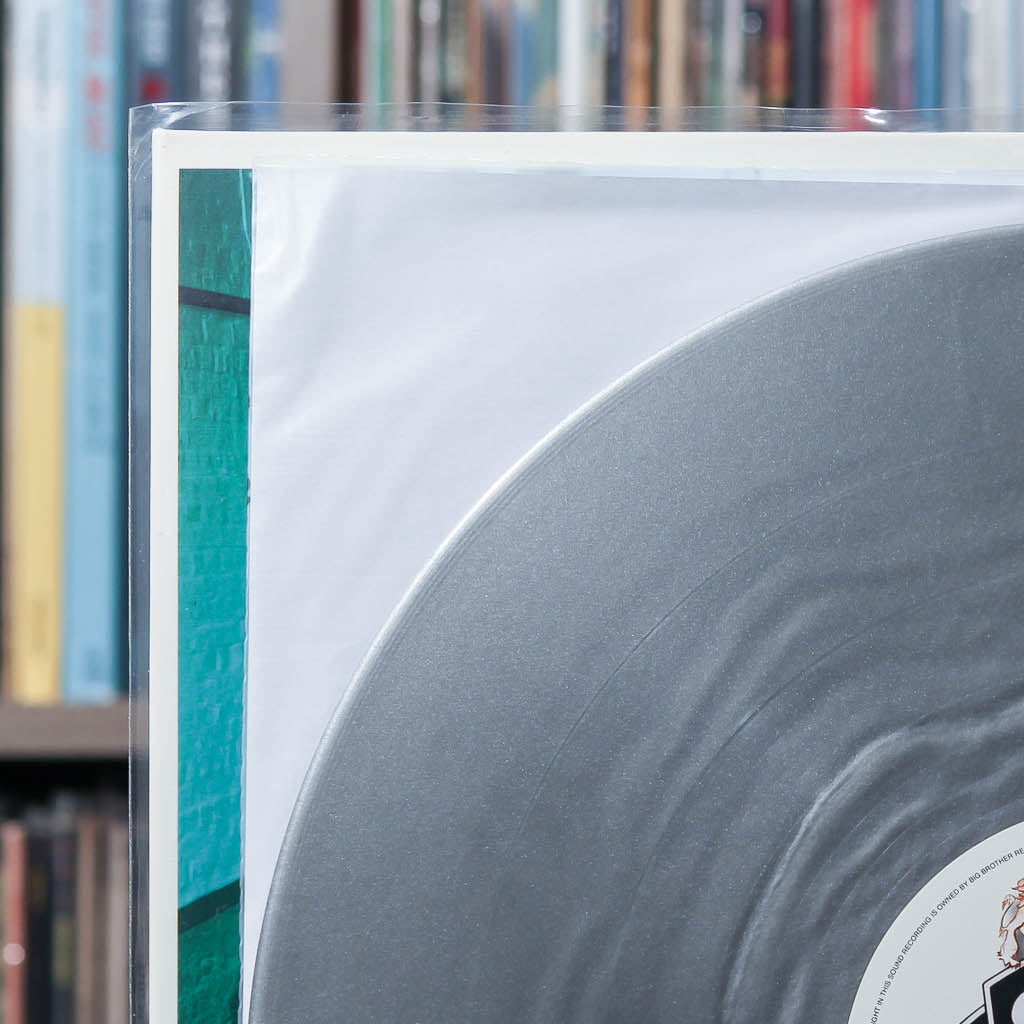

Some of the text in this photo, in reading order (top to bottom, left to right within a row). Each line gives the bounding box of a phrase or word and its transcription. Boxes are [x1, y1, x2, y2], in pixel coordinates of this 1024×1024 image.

[876, 997, 884, 1005] IN
[880, 981, 891, 996] THIS
[888, 955, 904, 980] SOUND
[901, 916, 932, 954] RECORDING
[930, 909, 937, 917] IS
[937, 889, 959, 910] OWNED
[959, 881, 968, 891] BY
[969, 872, 981, 883] BIG
[981, 853, 1013, 875] BROTHER
